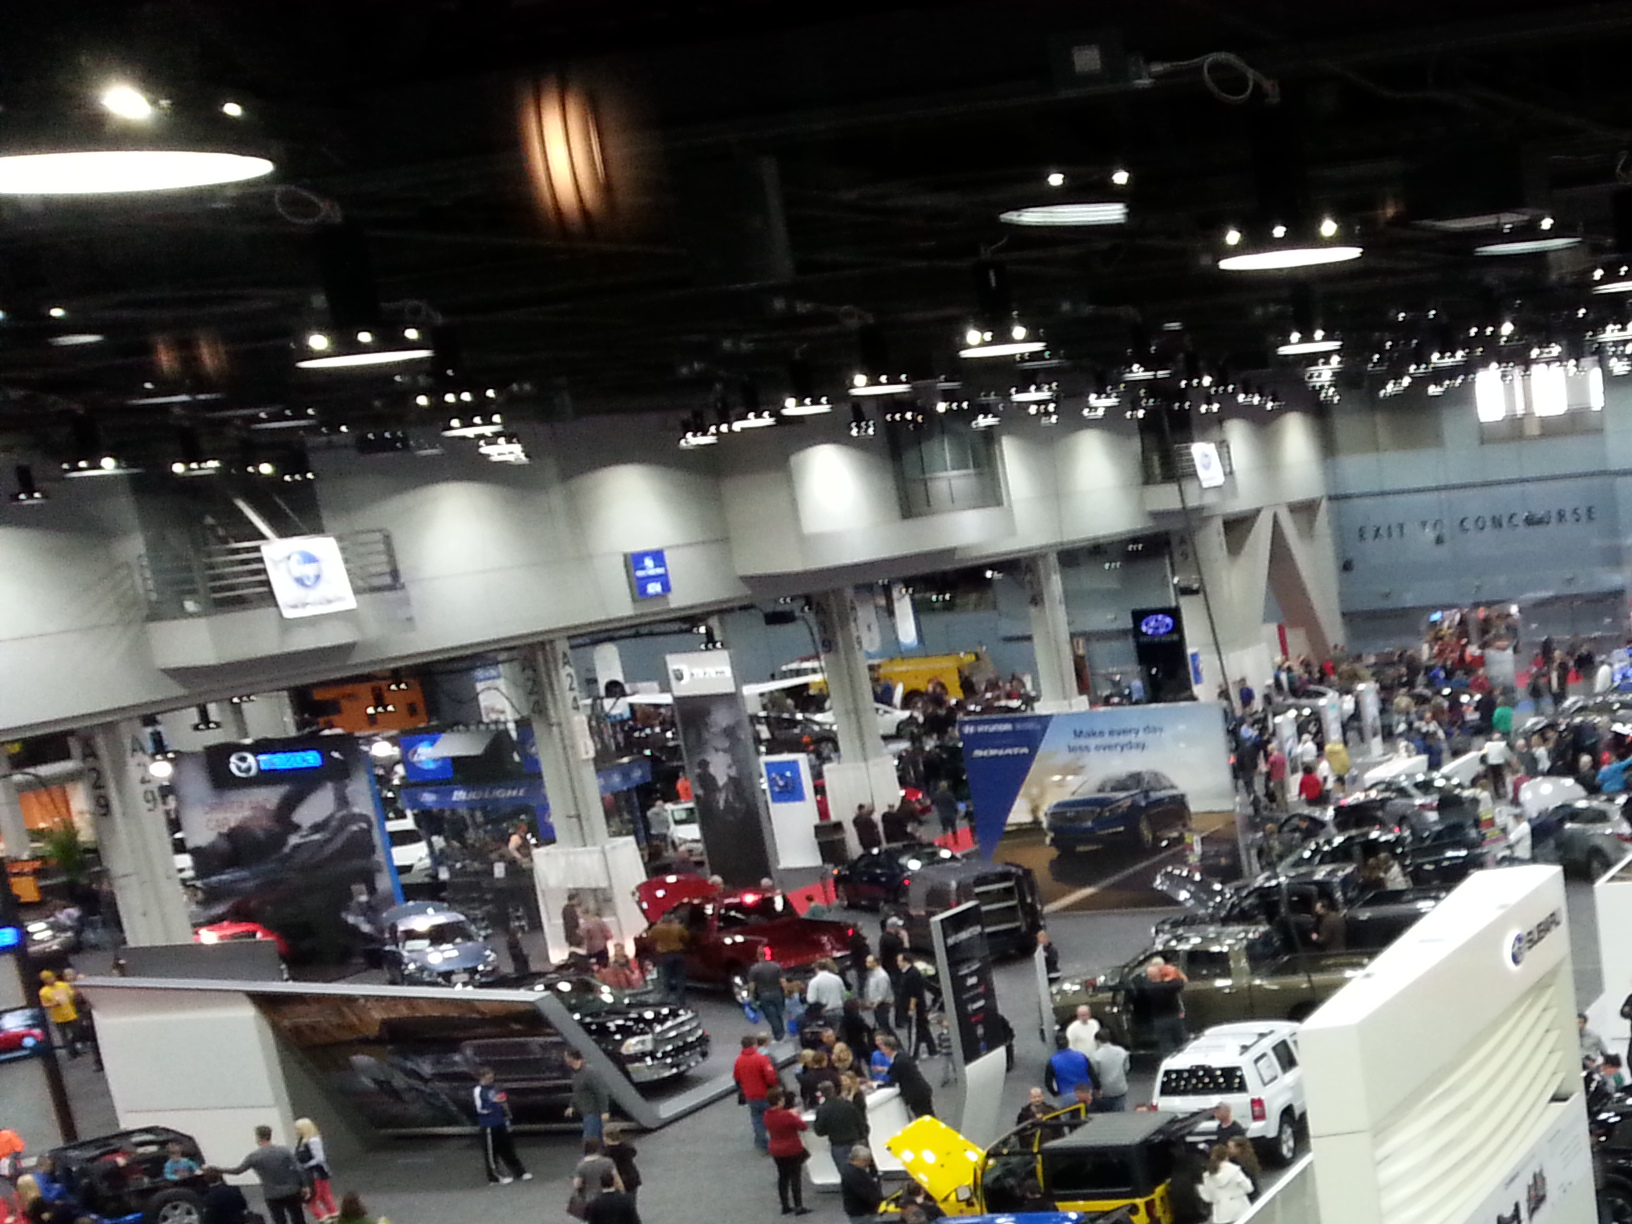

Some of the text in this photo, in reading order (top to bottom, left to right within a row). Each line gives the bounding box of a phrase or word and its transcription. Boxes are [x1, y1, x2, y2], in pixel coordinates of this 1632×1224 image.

[1357, 520, 1406, 543] EXIT
[562, 650, 581, 712] A24
[1073, 728, 1105, 739] Make
[1108, 727, 1140, 739] every
[972, 746, 1029, 758] SONATA
[1067, 744, 1091, 753] less
[81, 735, 111, 818] A29
[131, 734, 158, 813] A29
